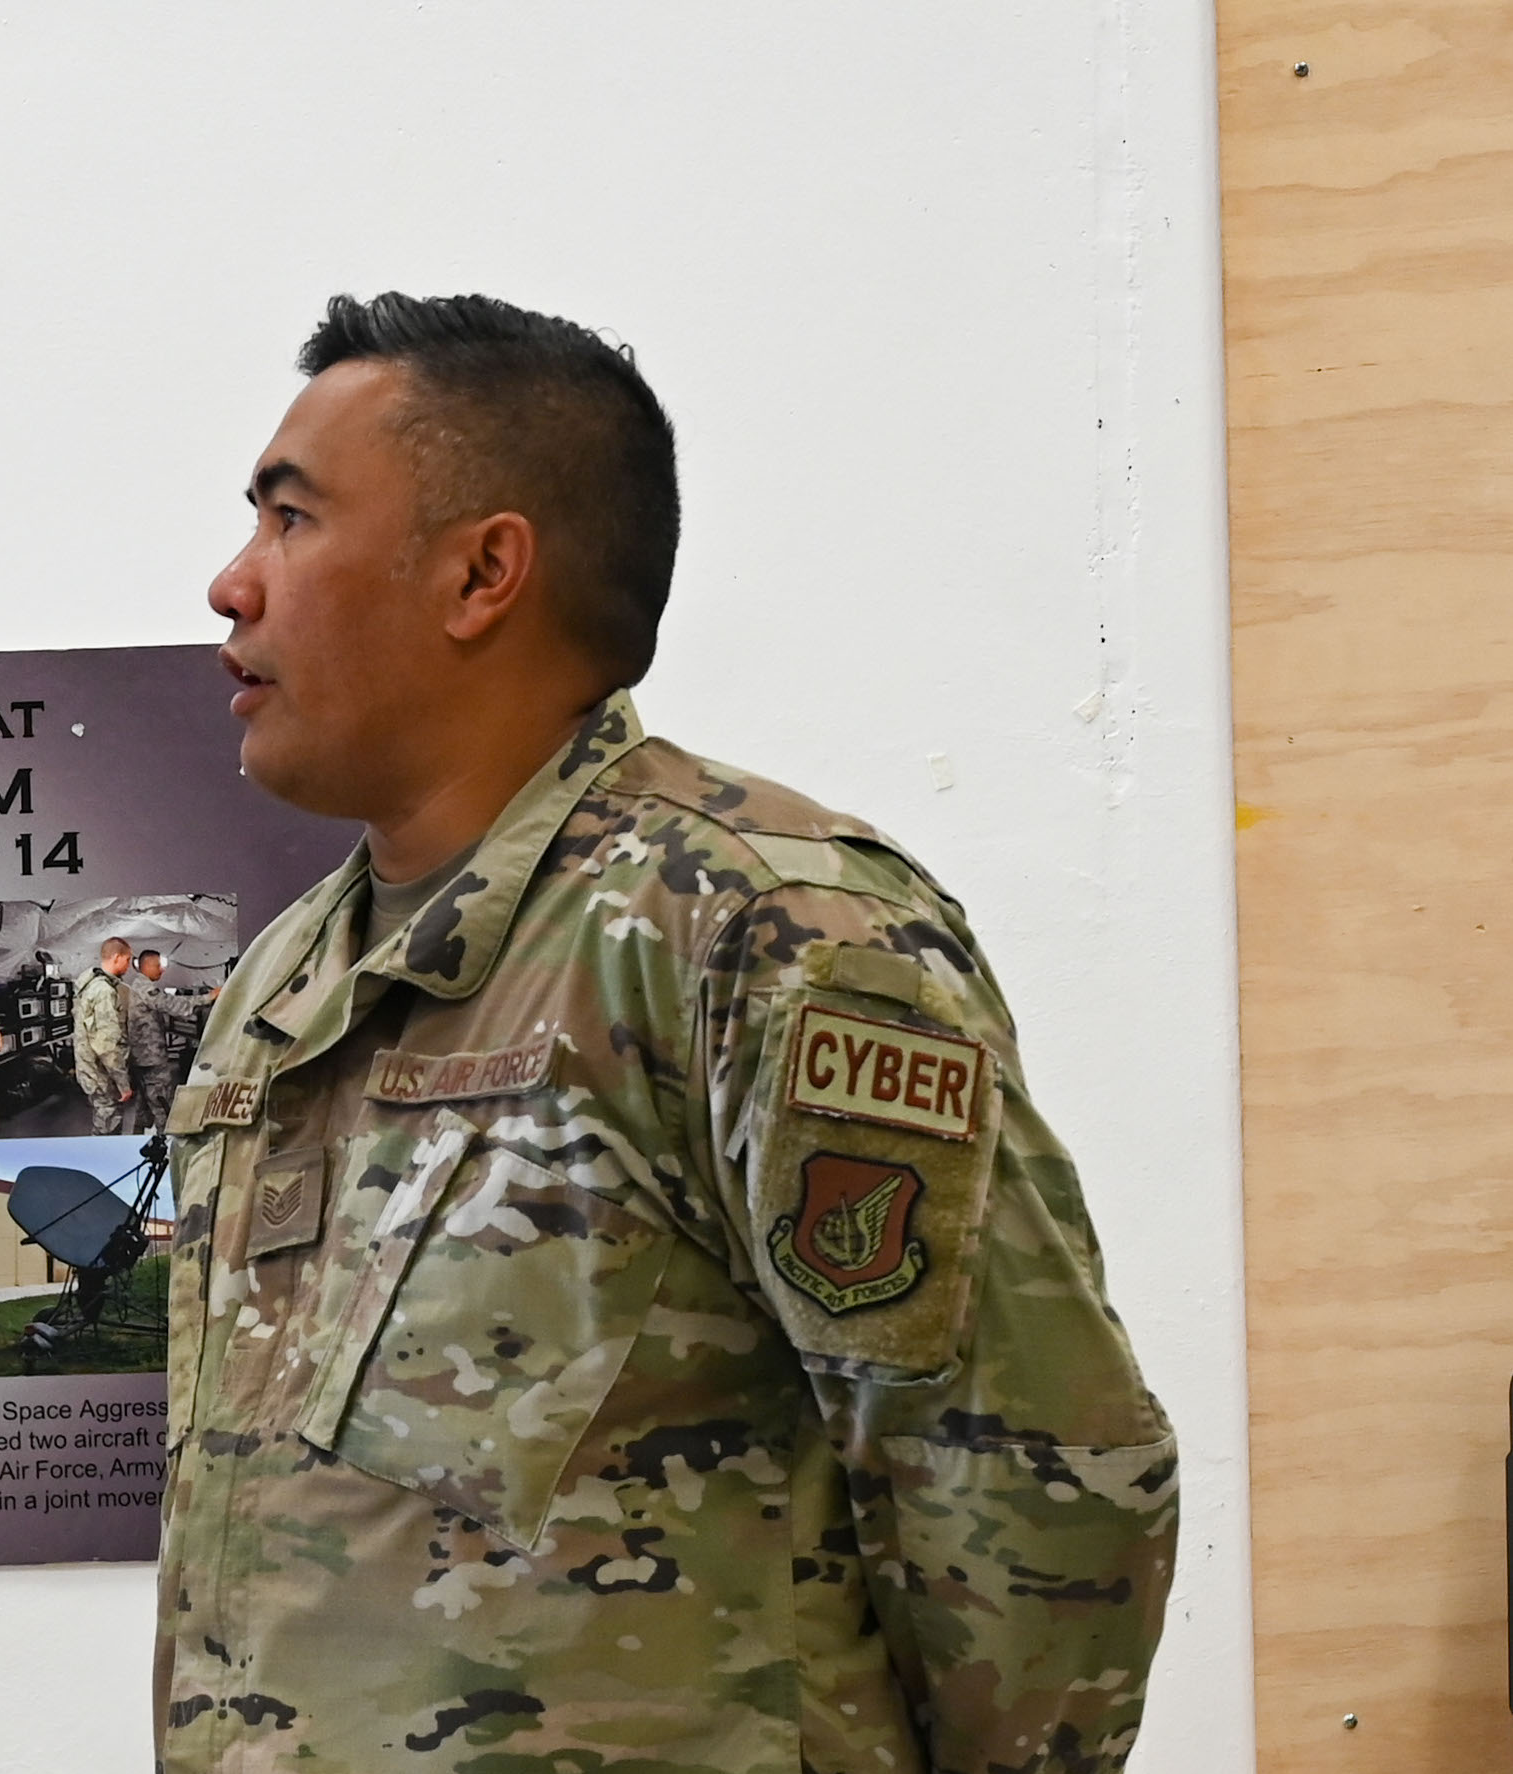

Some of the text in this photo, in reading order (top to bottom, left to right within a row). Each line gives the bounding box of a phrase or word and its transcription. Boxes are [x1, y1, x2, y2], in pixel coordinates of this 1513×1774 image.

[379, 1045, 546, 1098] U.S. AIR FORCE
[806, 1030, 968, 1120] CYBER
[778, 1252, 824, 1294] PACIFIC
[852, 1273, 909, 1301] FORCES
[2, 1400, 72, 1425] Space
[79, 1399, 168, 1424] Aggress
[29, 1432, 67, 1450] two
[74, 1427, 149, 1449] aircraft
[0, 1459, 29, 1481] Air
[36, 1459, 105, 1481] Force,
[109, 1458, 166, 1481] Army
[24, 1495, 38, 1510] a
[43, 1489, 90, 1514] joint
